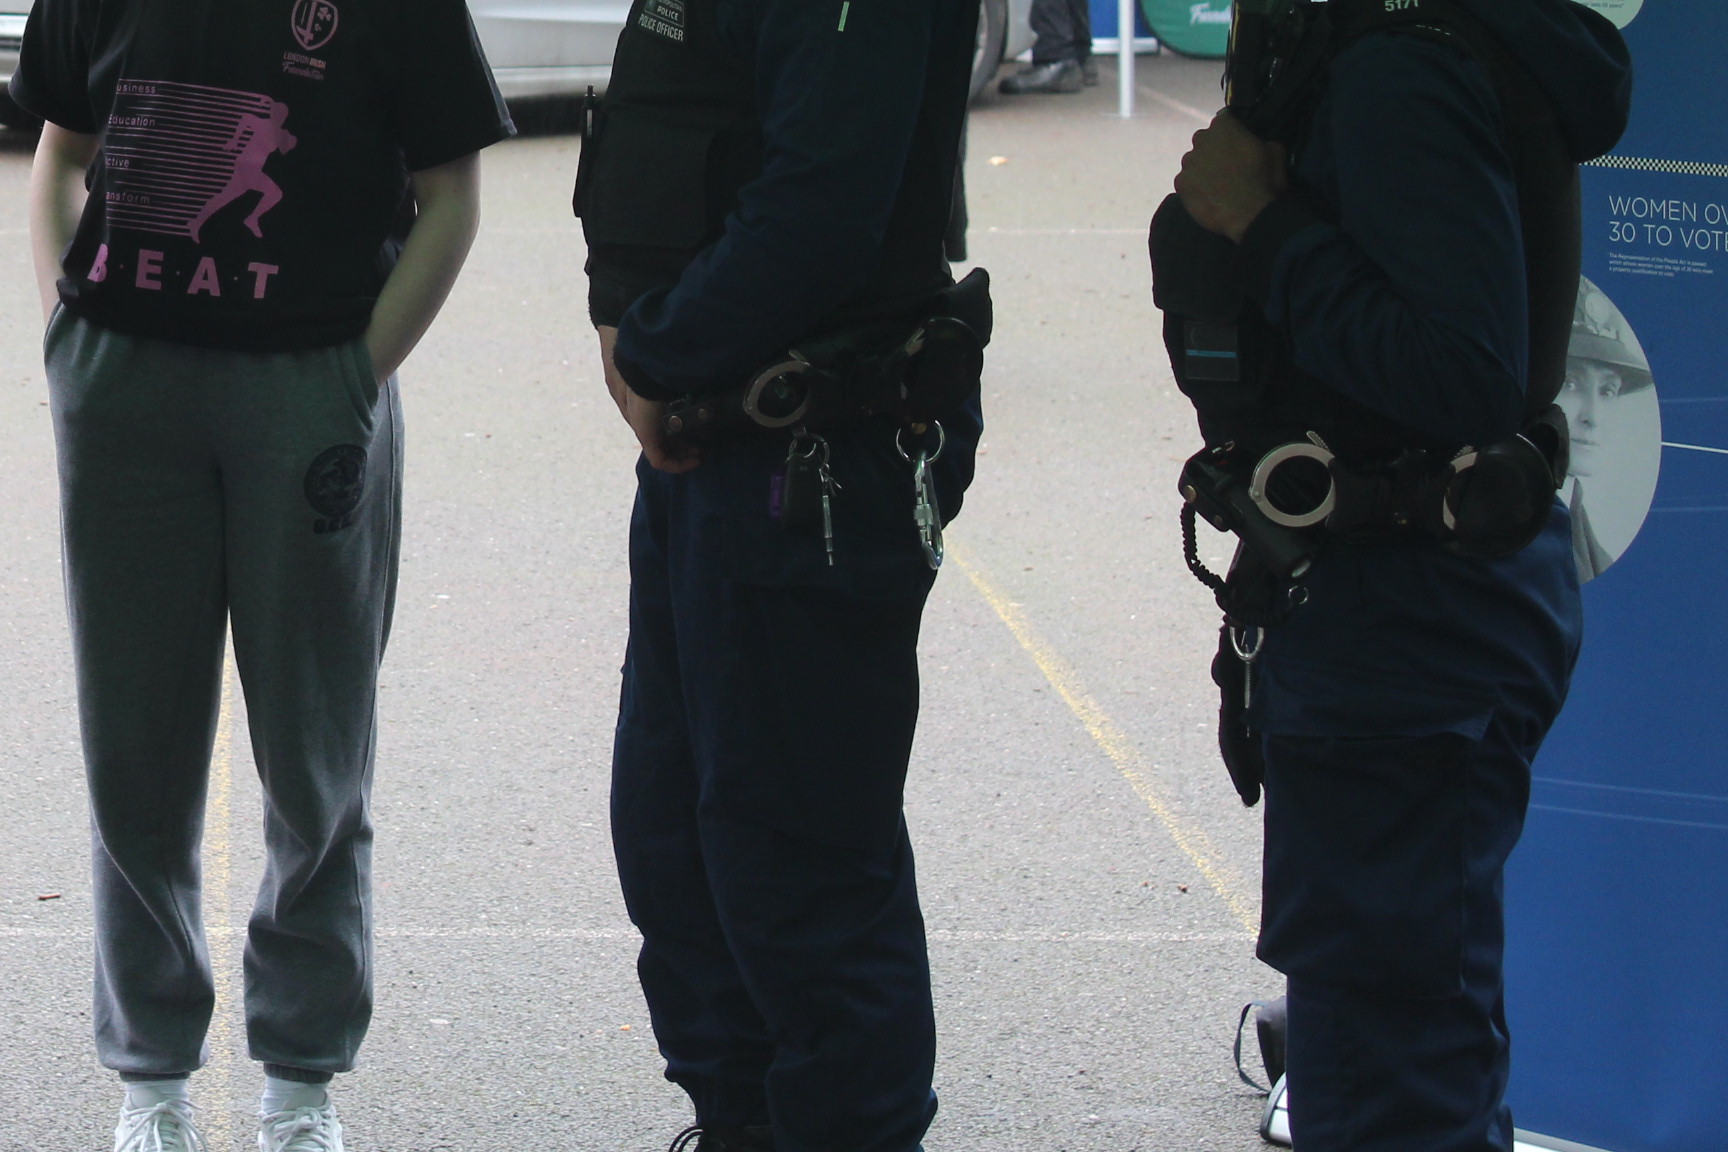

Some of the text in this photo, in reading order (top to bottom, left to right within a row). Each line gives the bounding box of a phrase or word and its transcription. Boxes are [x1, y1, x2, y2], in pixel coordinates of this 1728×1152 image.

[657, 5, 679, 21] POLICE
[638, 13, 684, 42] POLICE OFFICER
[116, 84, 156, 94] usiness
[105, 155, 130, 168] ctive
[1608, 195, 1697, 223] WOMEN
[1608, 220, 1636, 243] 30
[1644, 224, 1673, 246] TO
